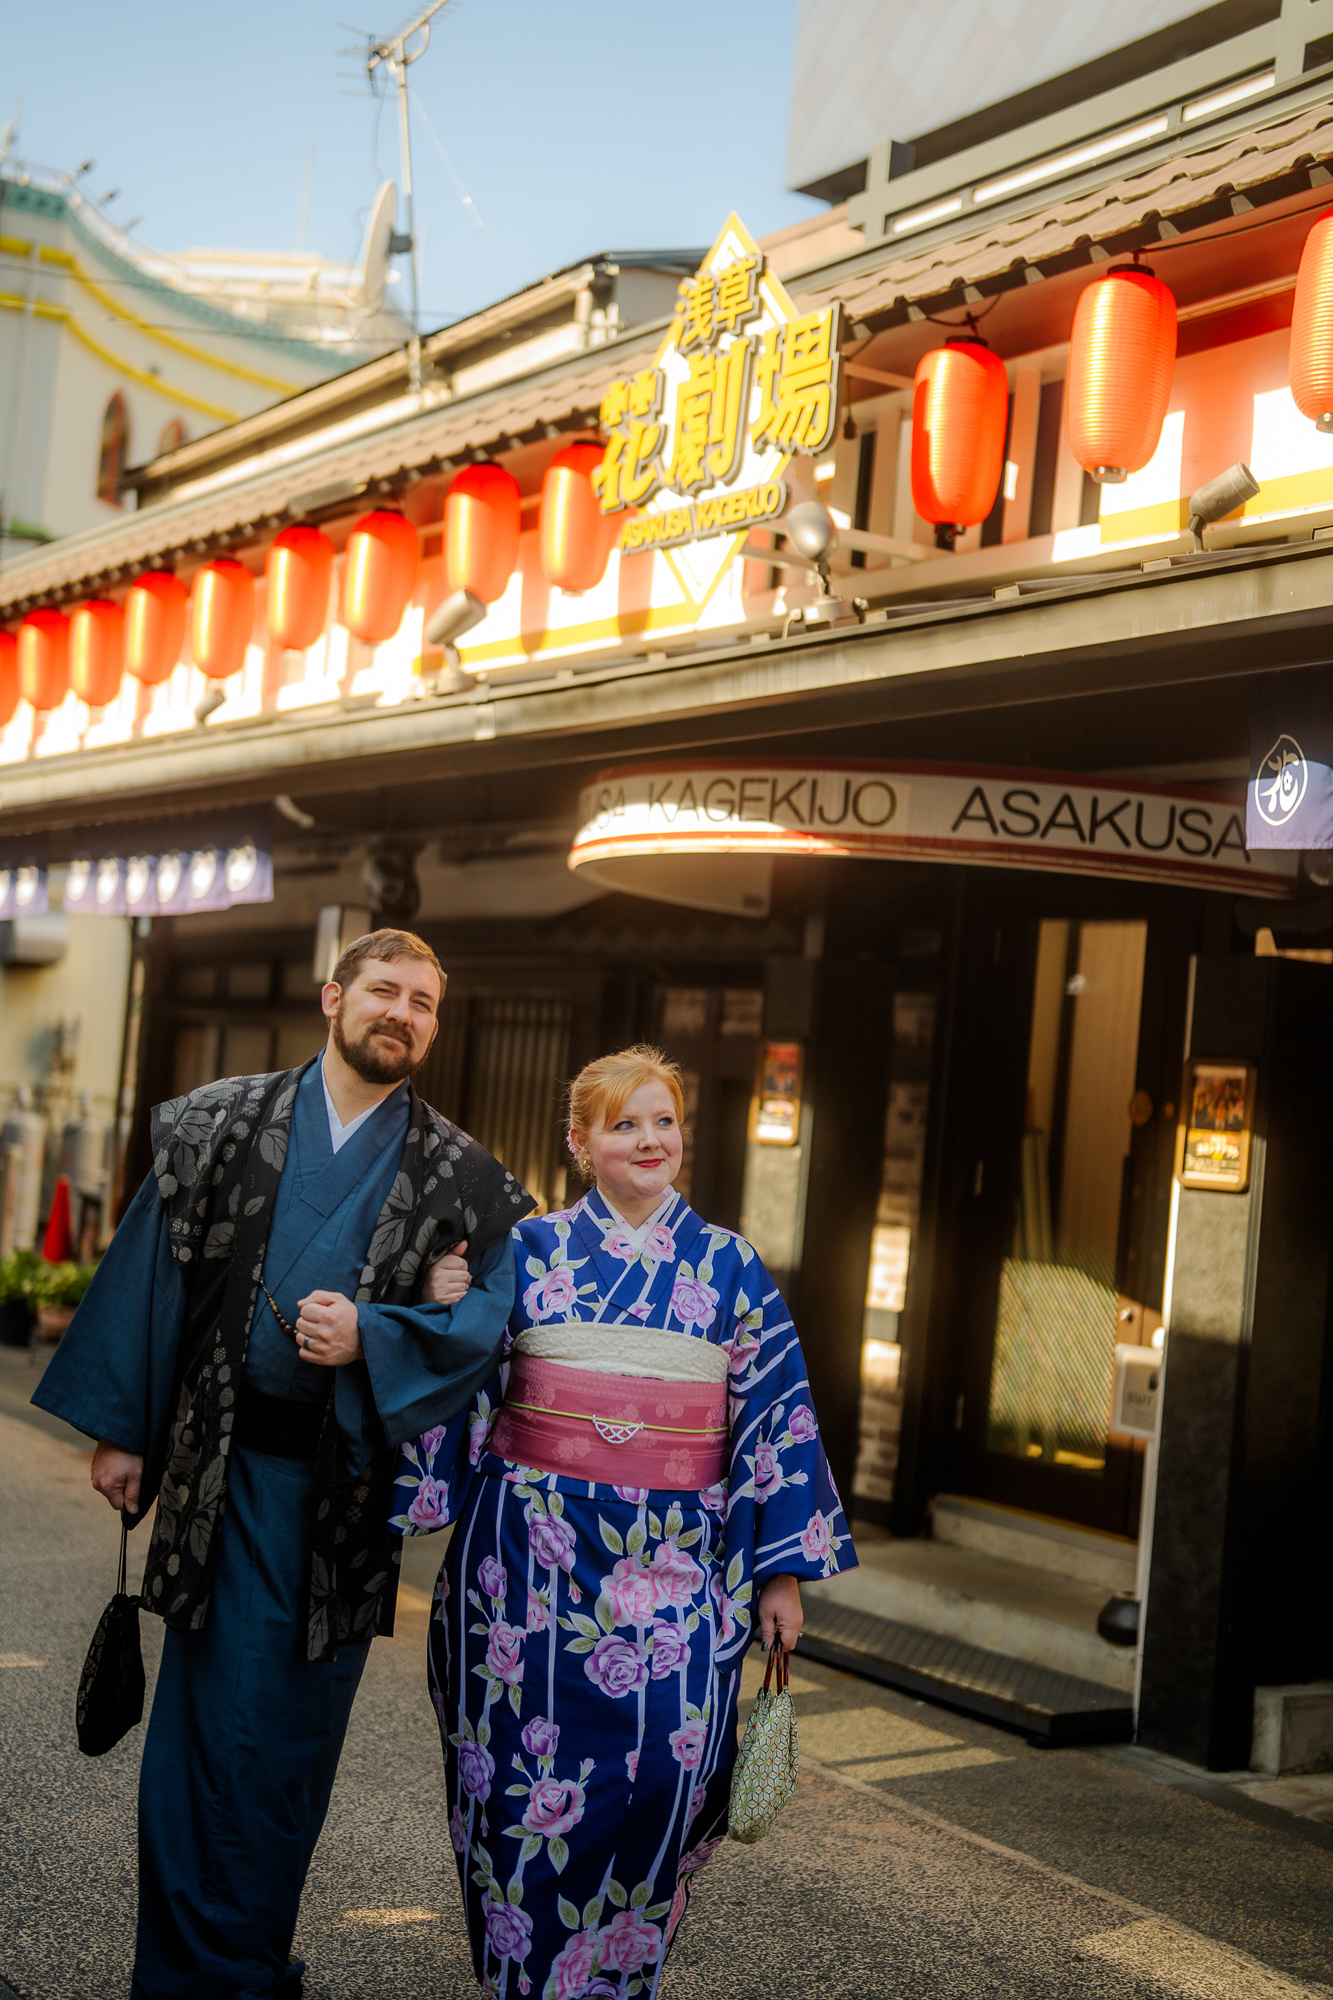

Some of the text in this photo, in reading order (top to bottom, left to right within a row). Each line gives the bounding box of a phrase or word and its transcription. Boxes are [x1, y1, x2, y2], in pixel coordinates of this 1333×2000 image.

[678, 255, 761, 347] 浅草
[592, 306, 836, 513] 花劇場
[621, 505, 693, 549] ASAKUSA
[649, 776, 898, 828] KAGEKIJO
[951, 786, 1252, 864] ASAKUSA
